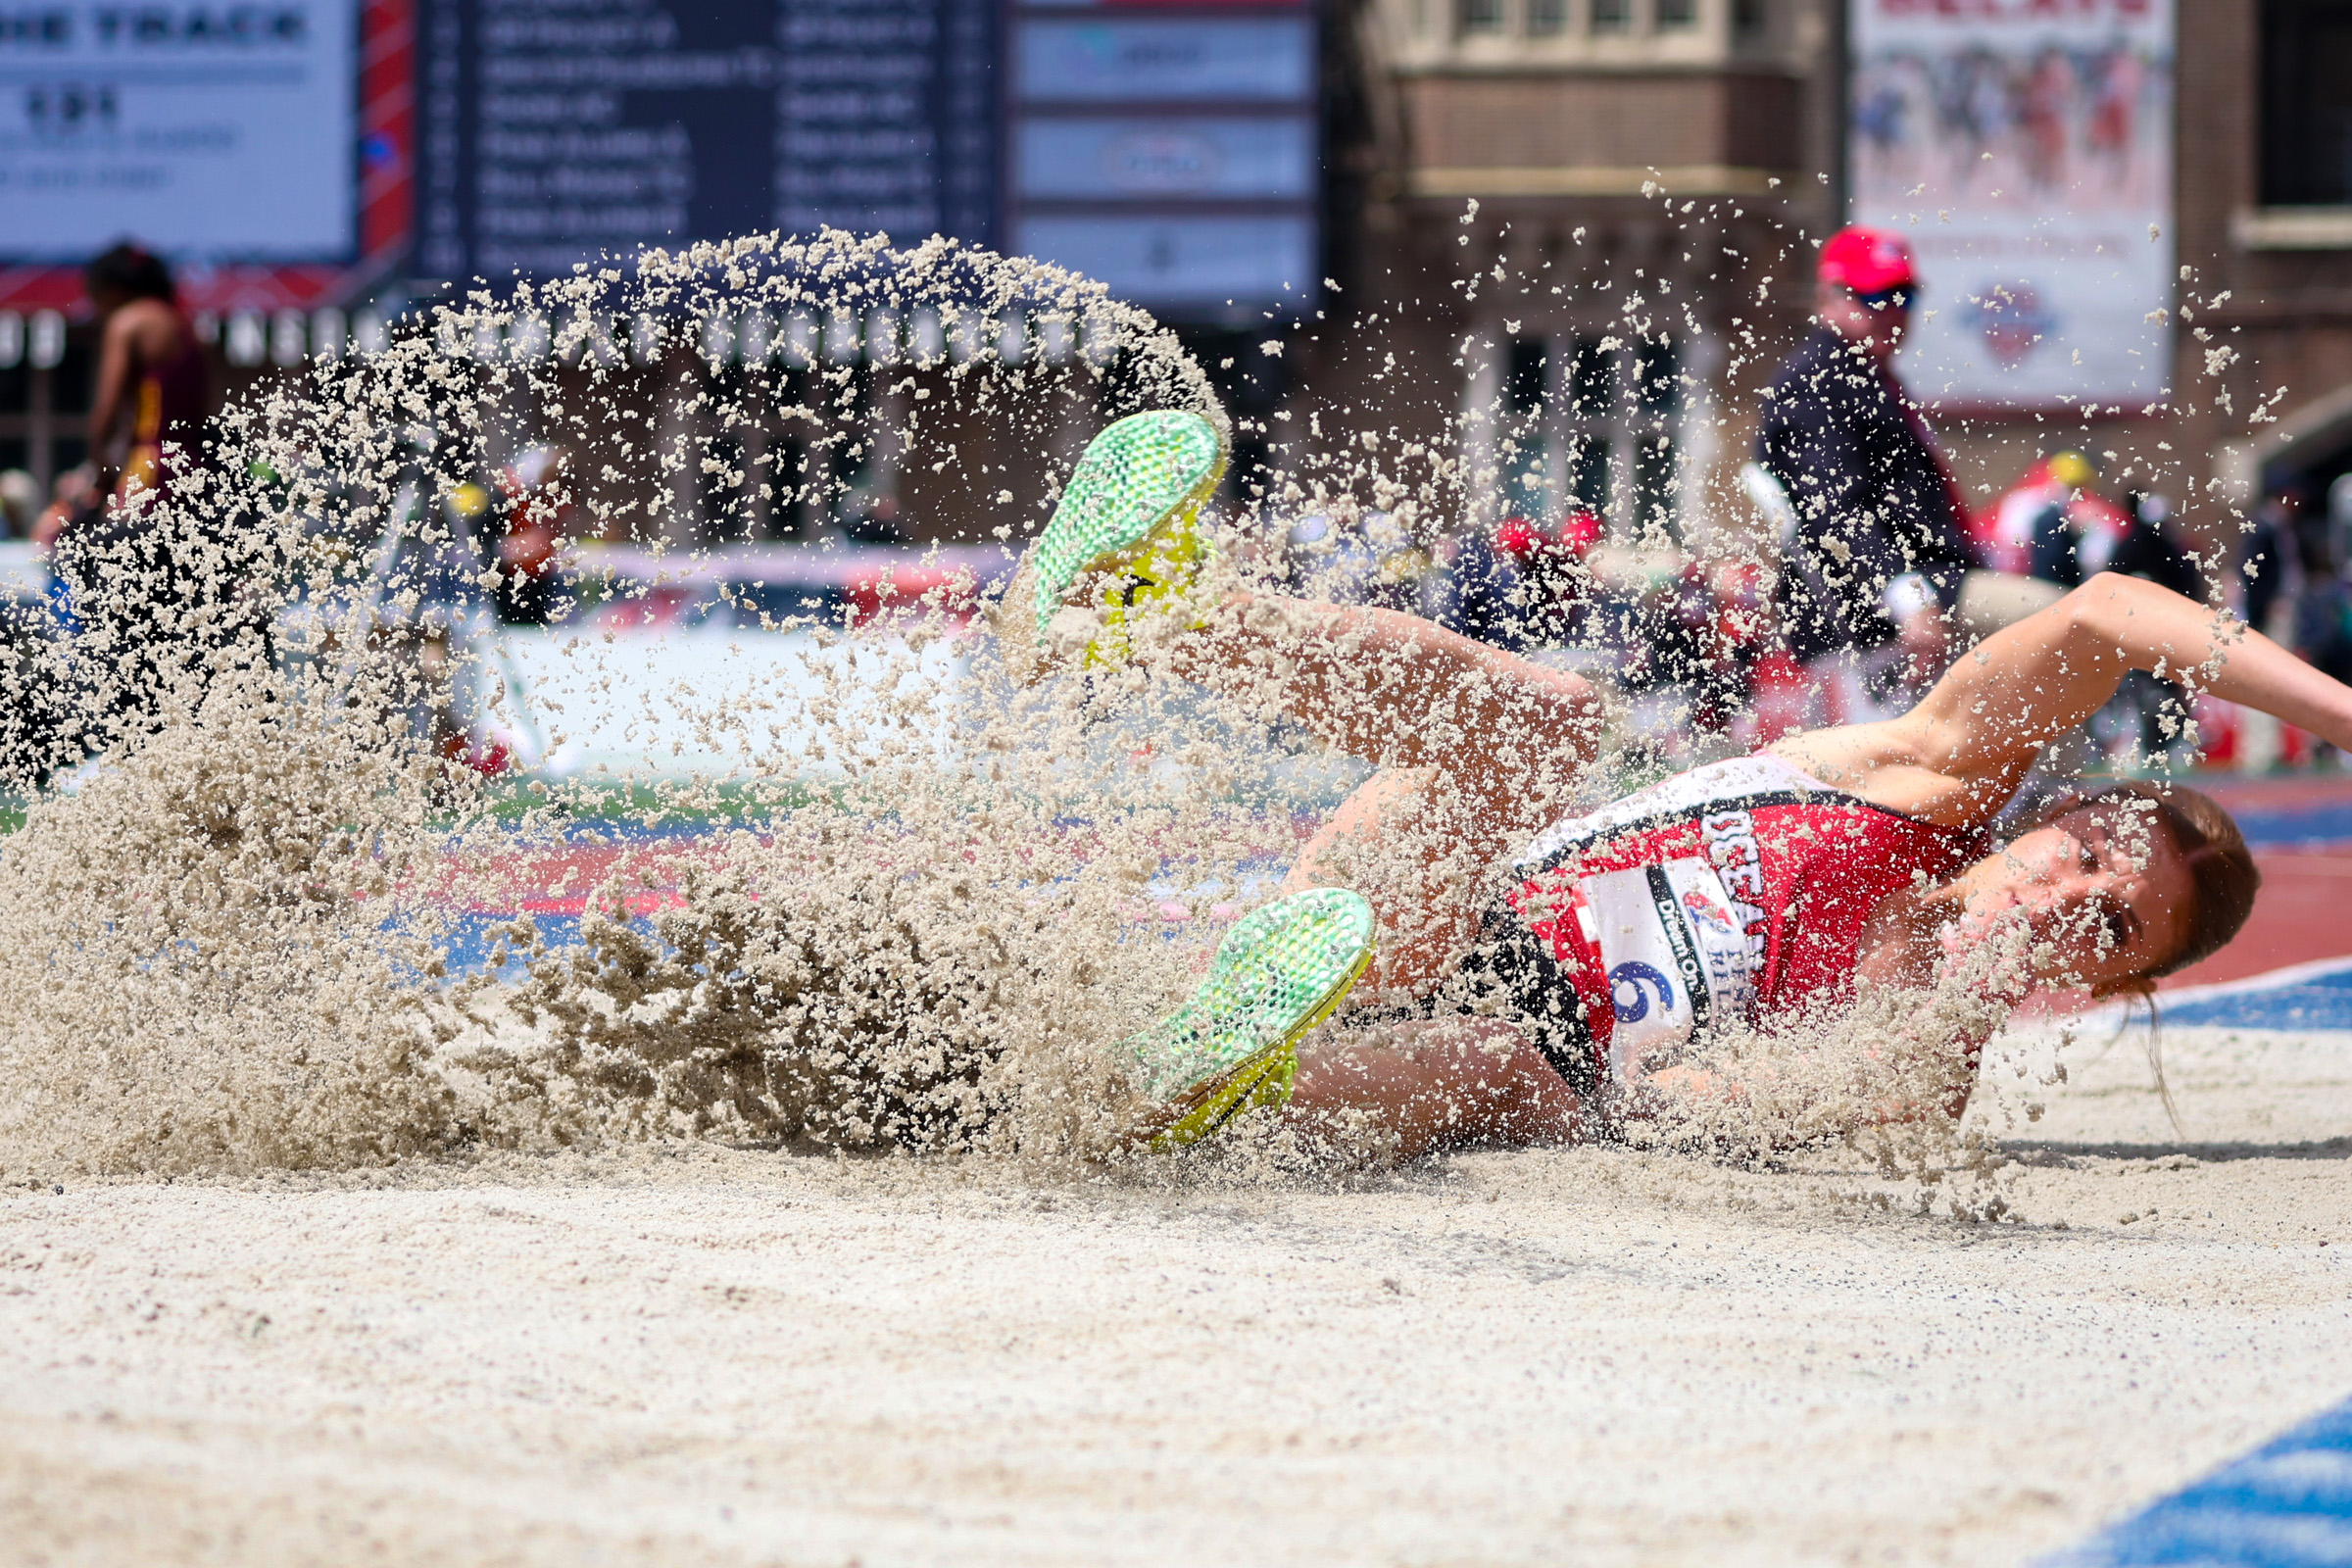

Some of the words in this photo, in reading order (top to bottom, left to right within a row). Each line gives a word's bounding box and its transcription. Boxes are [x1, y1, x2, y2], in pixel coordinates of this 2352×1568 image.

[96, 6, 306, 45] TRACK
[1657, 899, 1687, 957] Dream
[1681, 958, 1700, 991] On.
[1608, 961, 1674, 1022] 6
